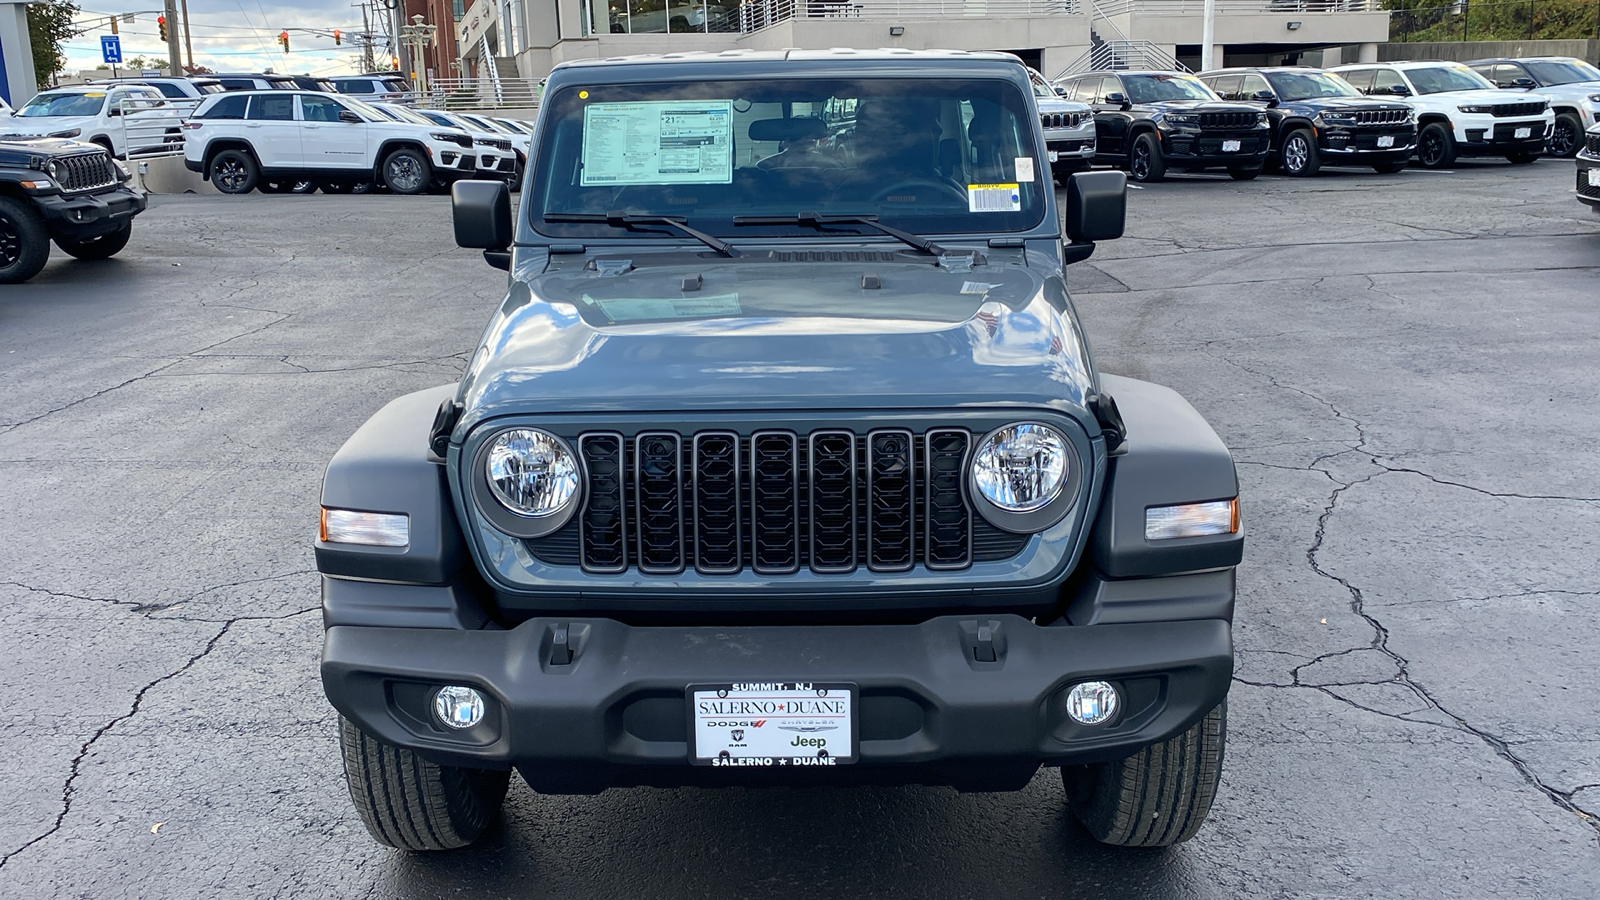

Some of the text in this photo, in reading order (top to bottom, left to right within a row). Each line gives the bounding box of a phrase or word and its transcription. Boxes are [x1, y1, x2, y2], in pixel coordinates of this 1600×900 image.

[105, 42, 117, 55] H
[665, 116, 675, 124] 21
[732, 683, 813, 692] SUMMIT, NJ
[699, 701, 846, 715] SALERNO DUANE
[790, 735, 827, 749] Jeep
[712, 757, 836, 767] SALERNO DUANE
